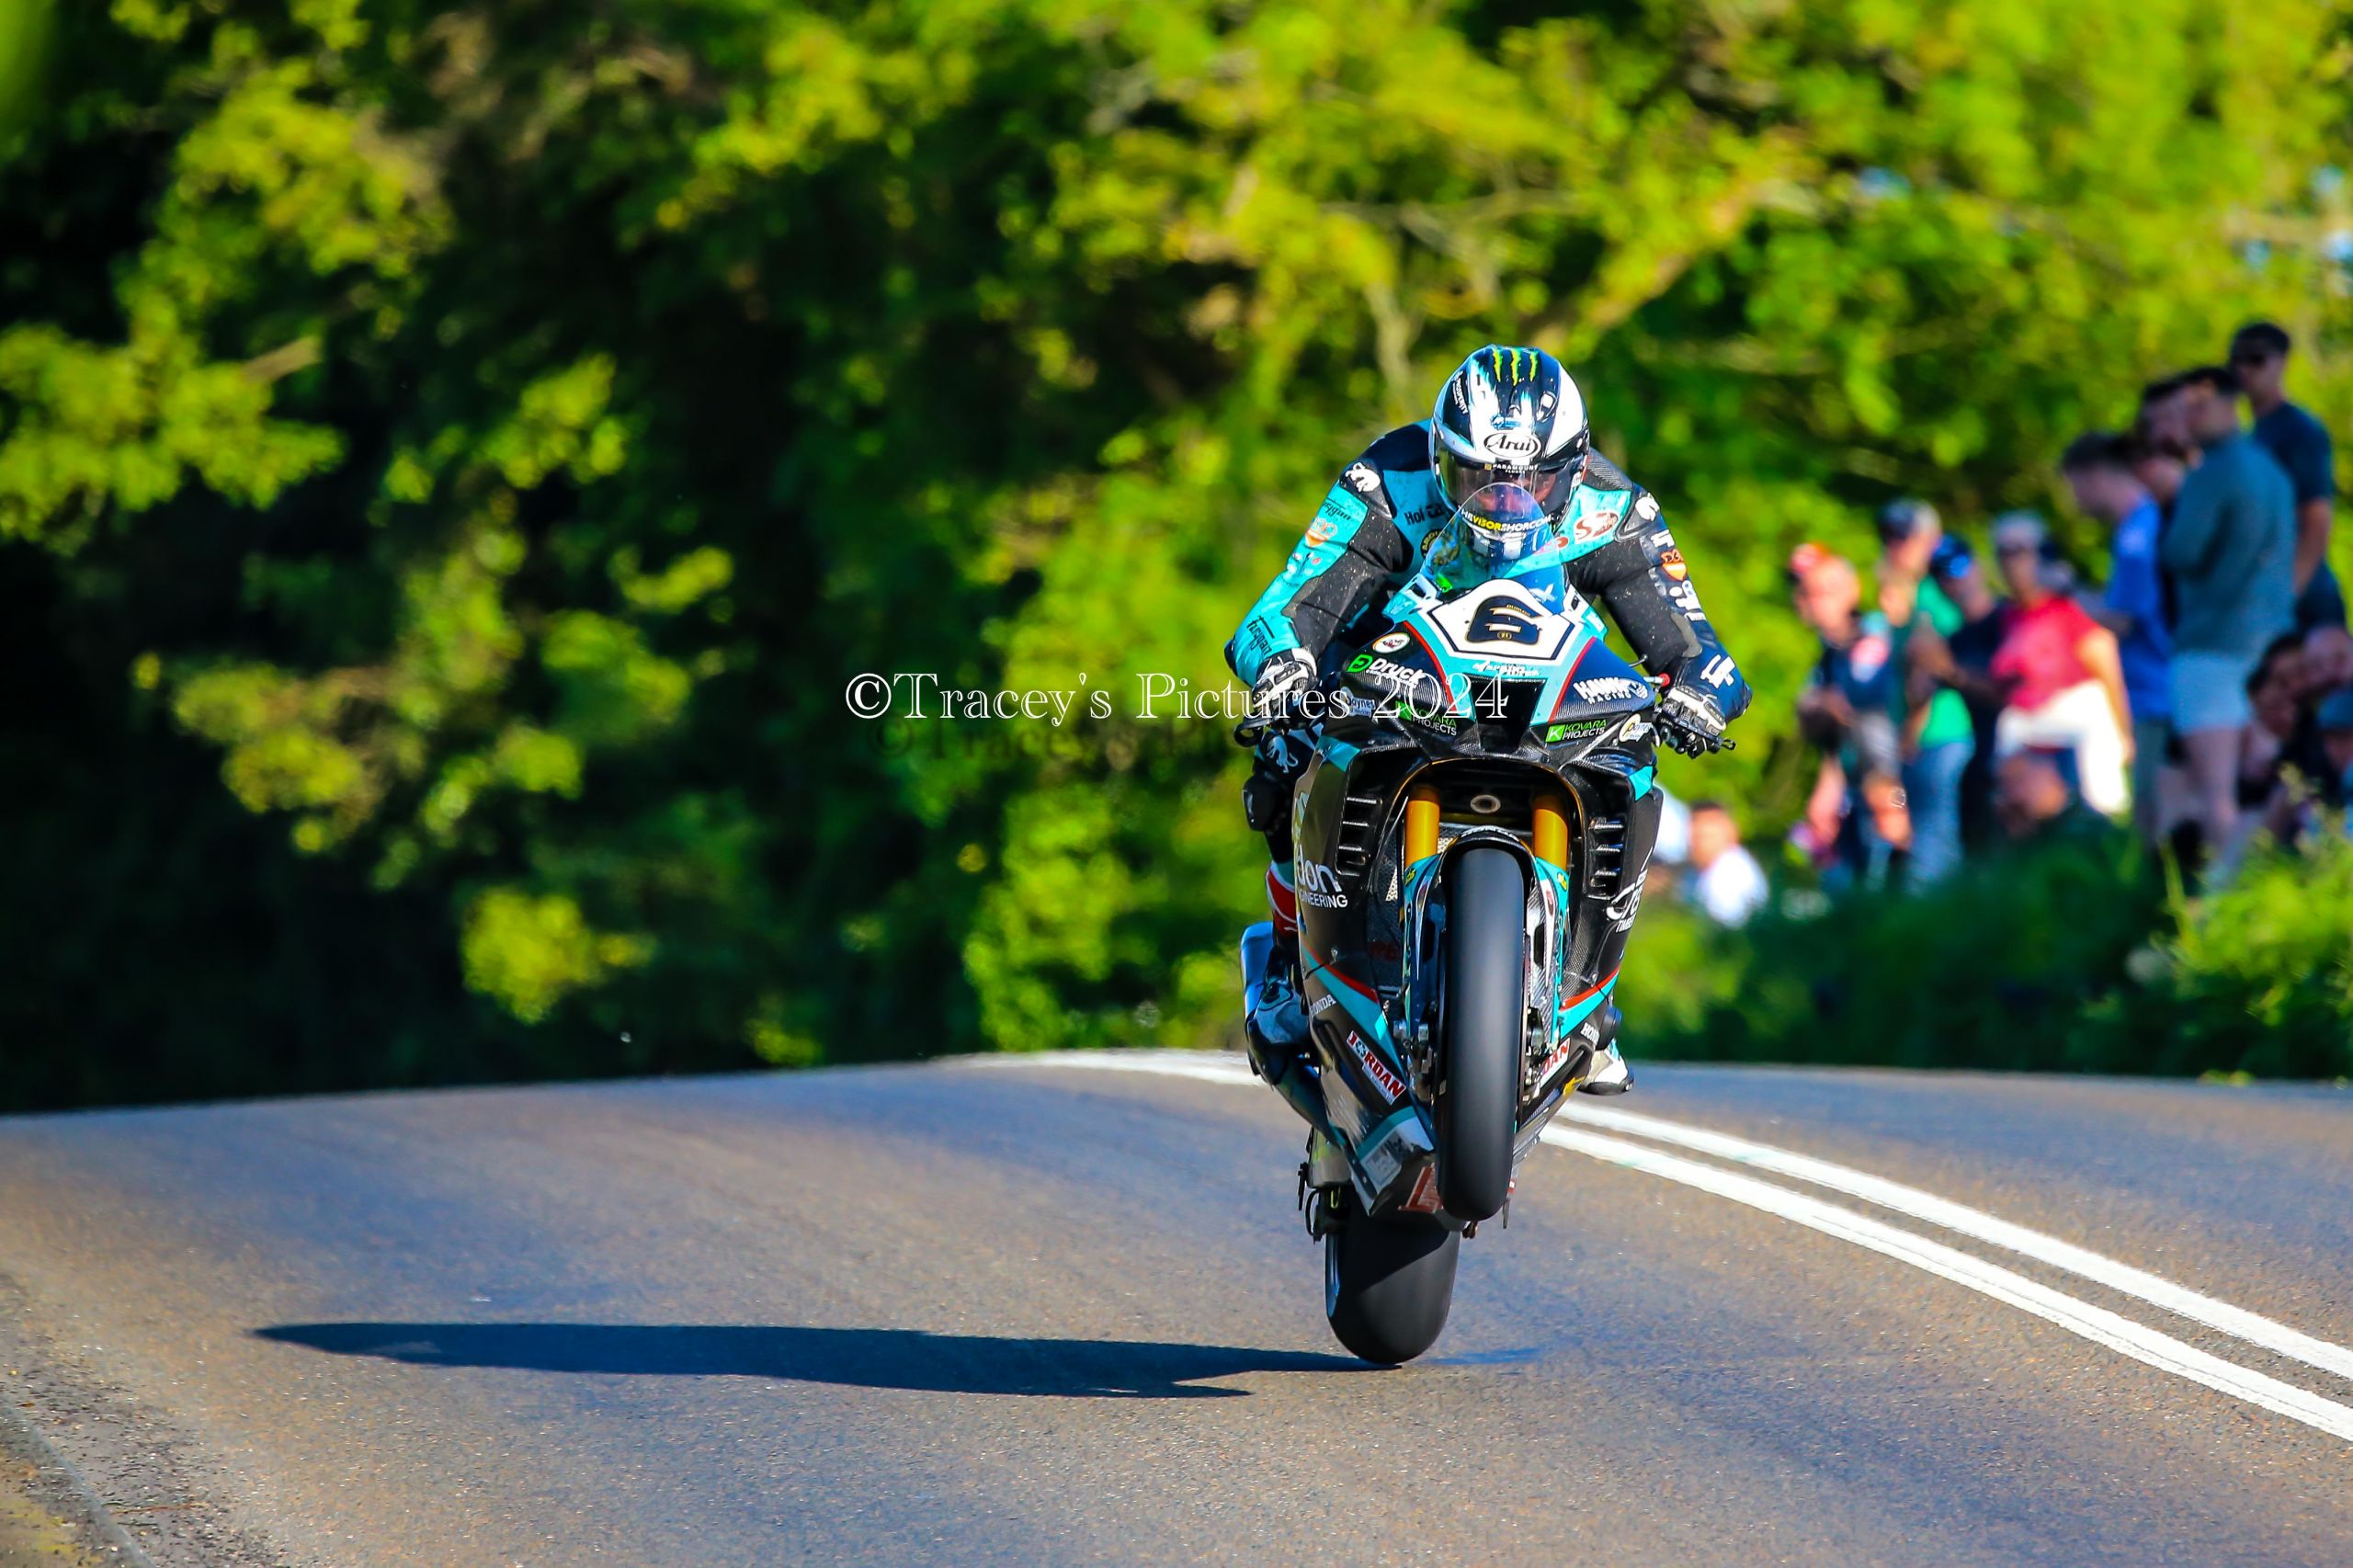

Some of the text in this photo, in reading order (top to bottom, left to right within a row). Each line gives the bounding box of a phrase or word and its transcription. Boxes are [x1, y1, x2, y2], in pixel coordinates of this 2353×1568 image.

[1487, 435, 1532, 451] Arai
[1465, 595, 1545, 645] 6
[1369, 657, 1427, 686] Druck
[1412, 715, 1457, 736] PROJECTS
[1562, 727, 1606, 741] PROJECTS
[1563, 719, 1608, 733] KOVARA
